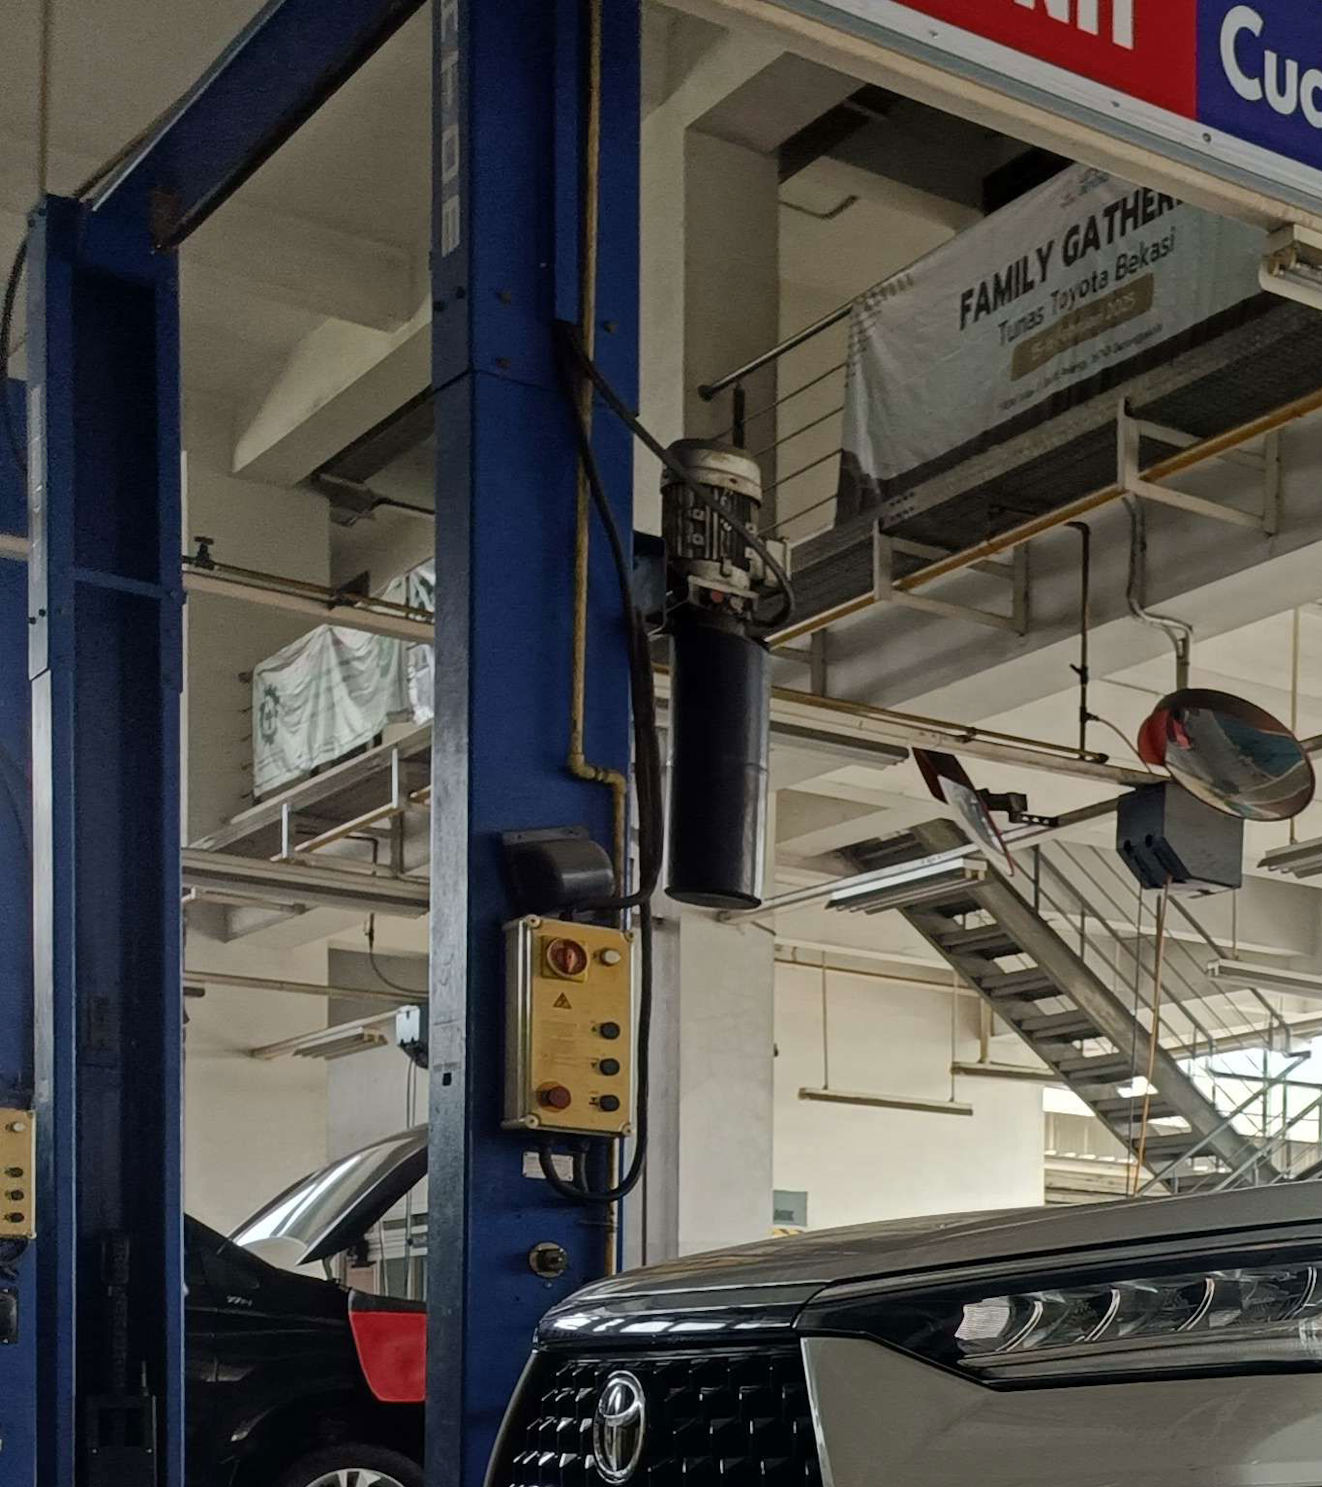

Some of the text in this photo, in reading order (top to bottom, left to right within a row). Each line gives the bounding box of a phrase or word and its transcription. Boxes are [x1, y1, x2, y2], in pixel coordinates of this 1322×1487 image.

[959, 186, 1184, 331] FAMILY GATHER
[998, 310, 1045, 348] Tunas
[1050, 269, 1109, 314] Toyota
[1114, 226, 1177, 282] Bekasi
